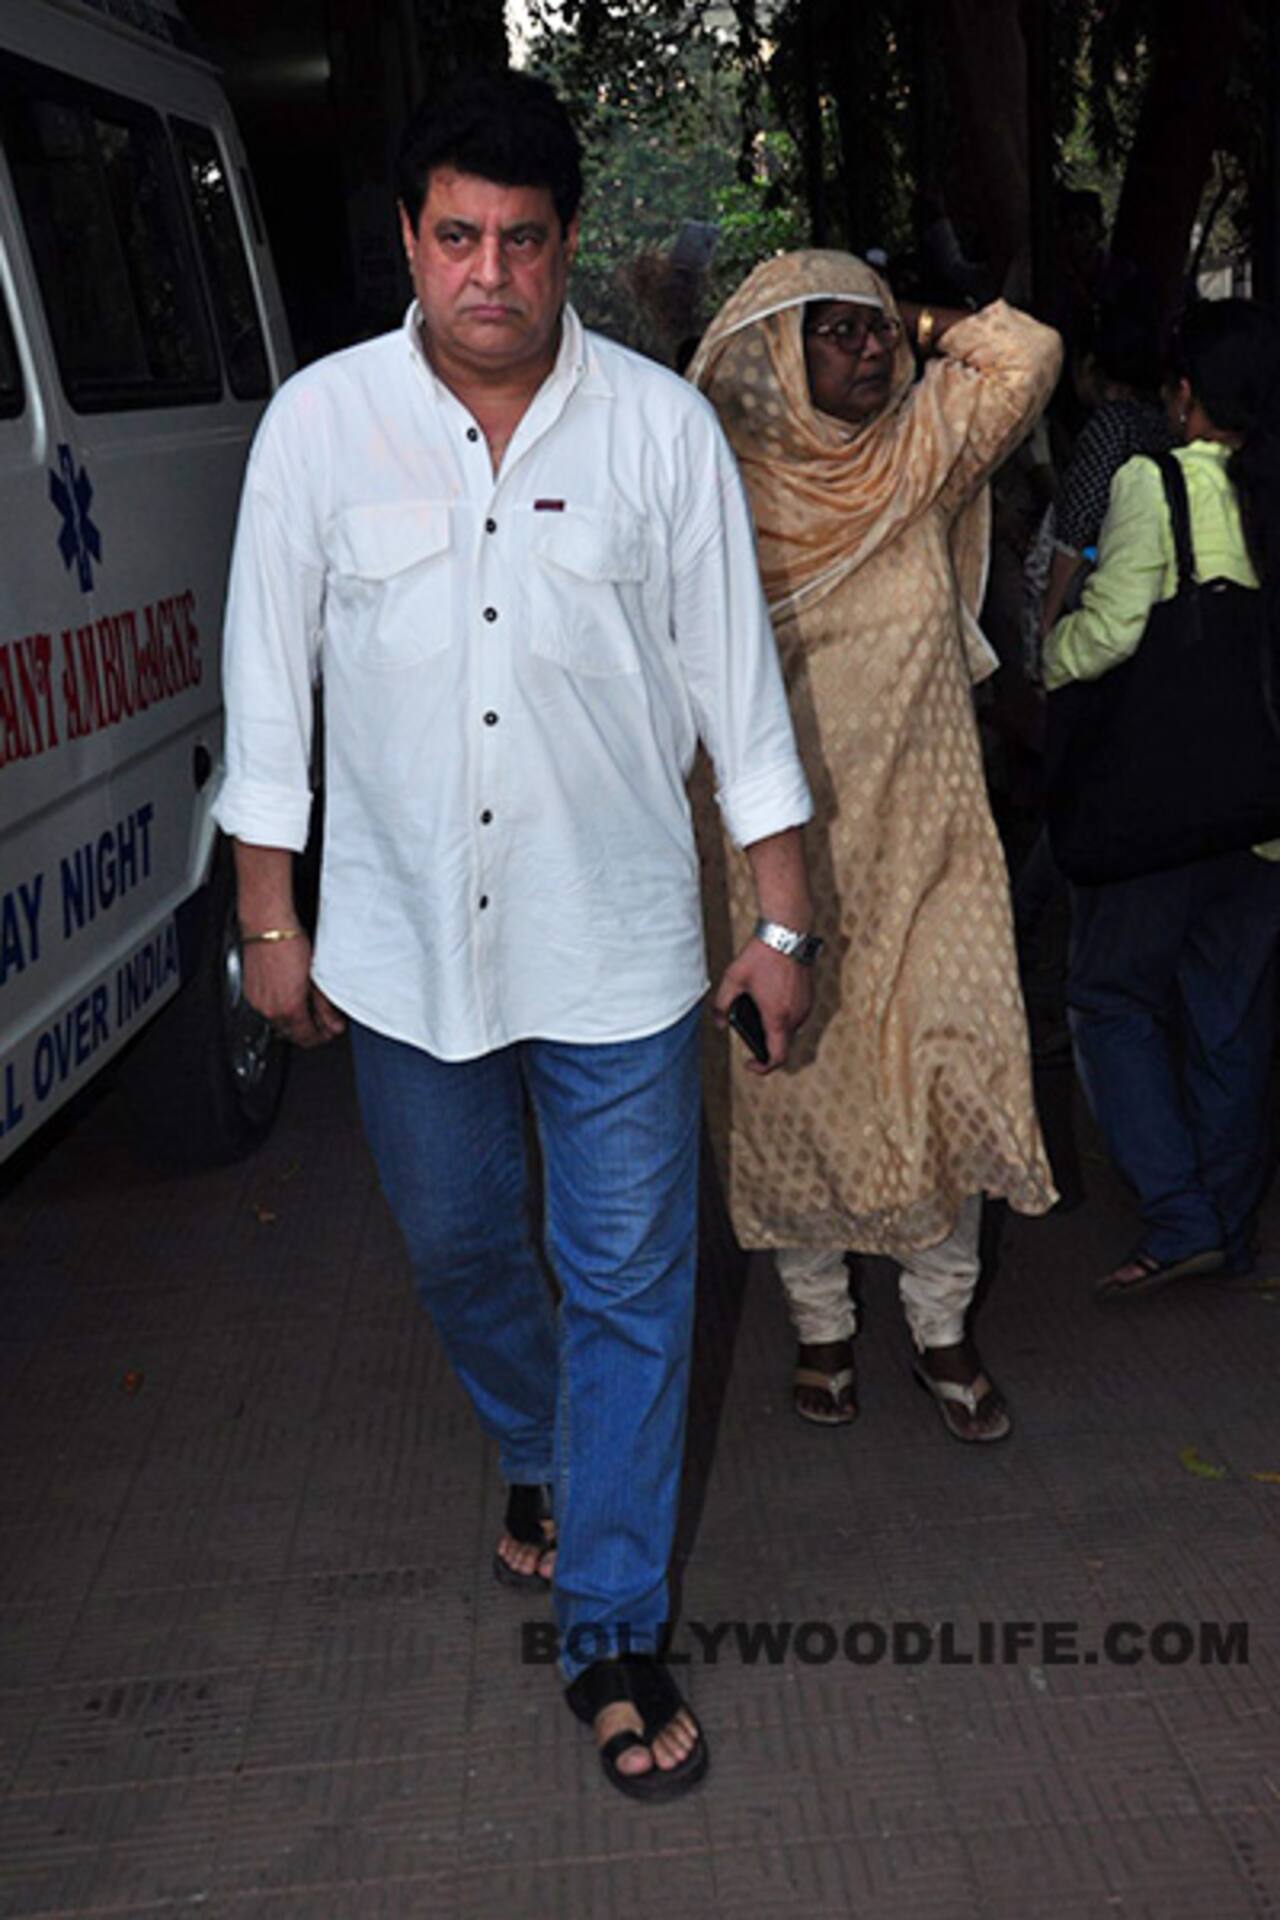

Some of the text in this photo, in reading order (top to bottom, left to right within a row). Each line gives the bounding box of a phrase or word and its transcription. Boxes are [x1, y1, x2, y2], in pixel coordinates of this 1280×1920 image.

[0, 633, 58, 768] ANT
[60, 802, 154, 939] NIGHT
[0, 925, 178, 1137] L OVER INDIA
